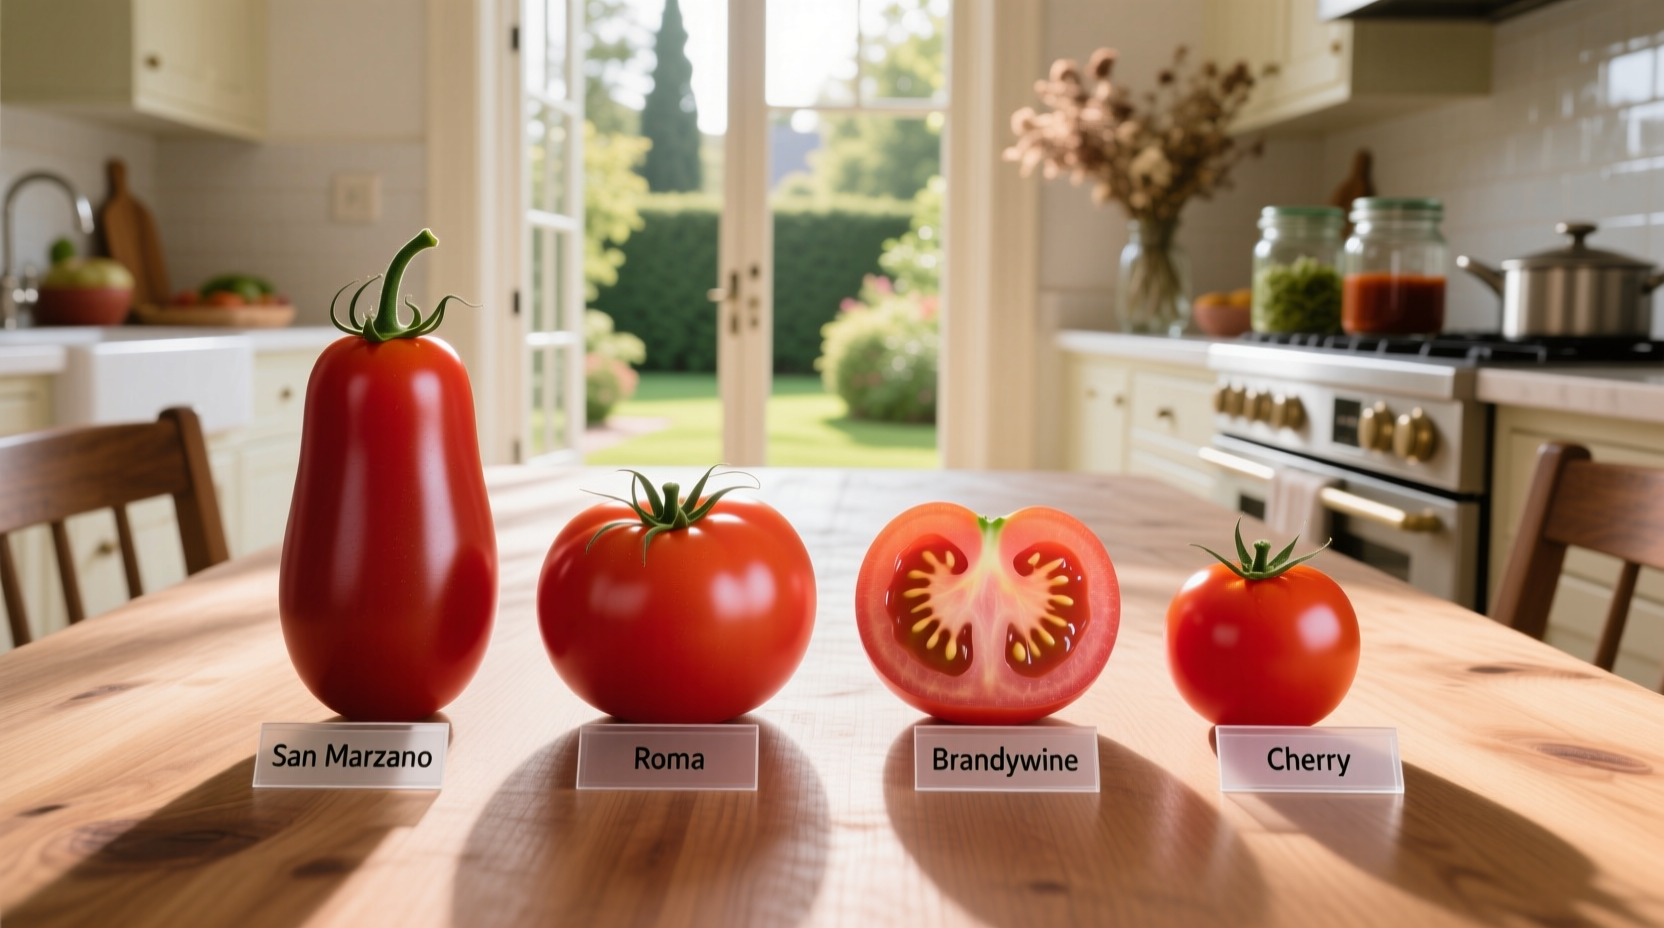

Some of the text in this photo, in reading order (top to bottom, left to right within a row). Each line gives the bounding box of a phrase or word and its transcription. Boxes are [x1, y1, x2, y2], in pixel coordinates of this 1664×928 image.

[271, 743, 433, 768] San Marzano
[634, 745, 705, 771] Roma
[932, 745, 1079, 778] Brandywine
[1267, 746, 1351, 777] Cherry
